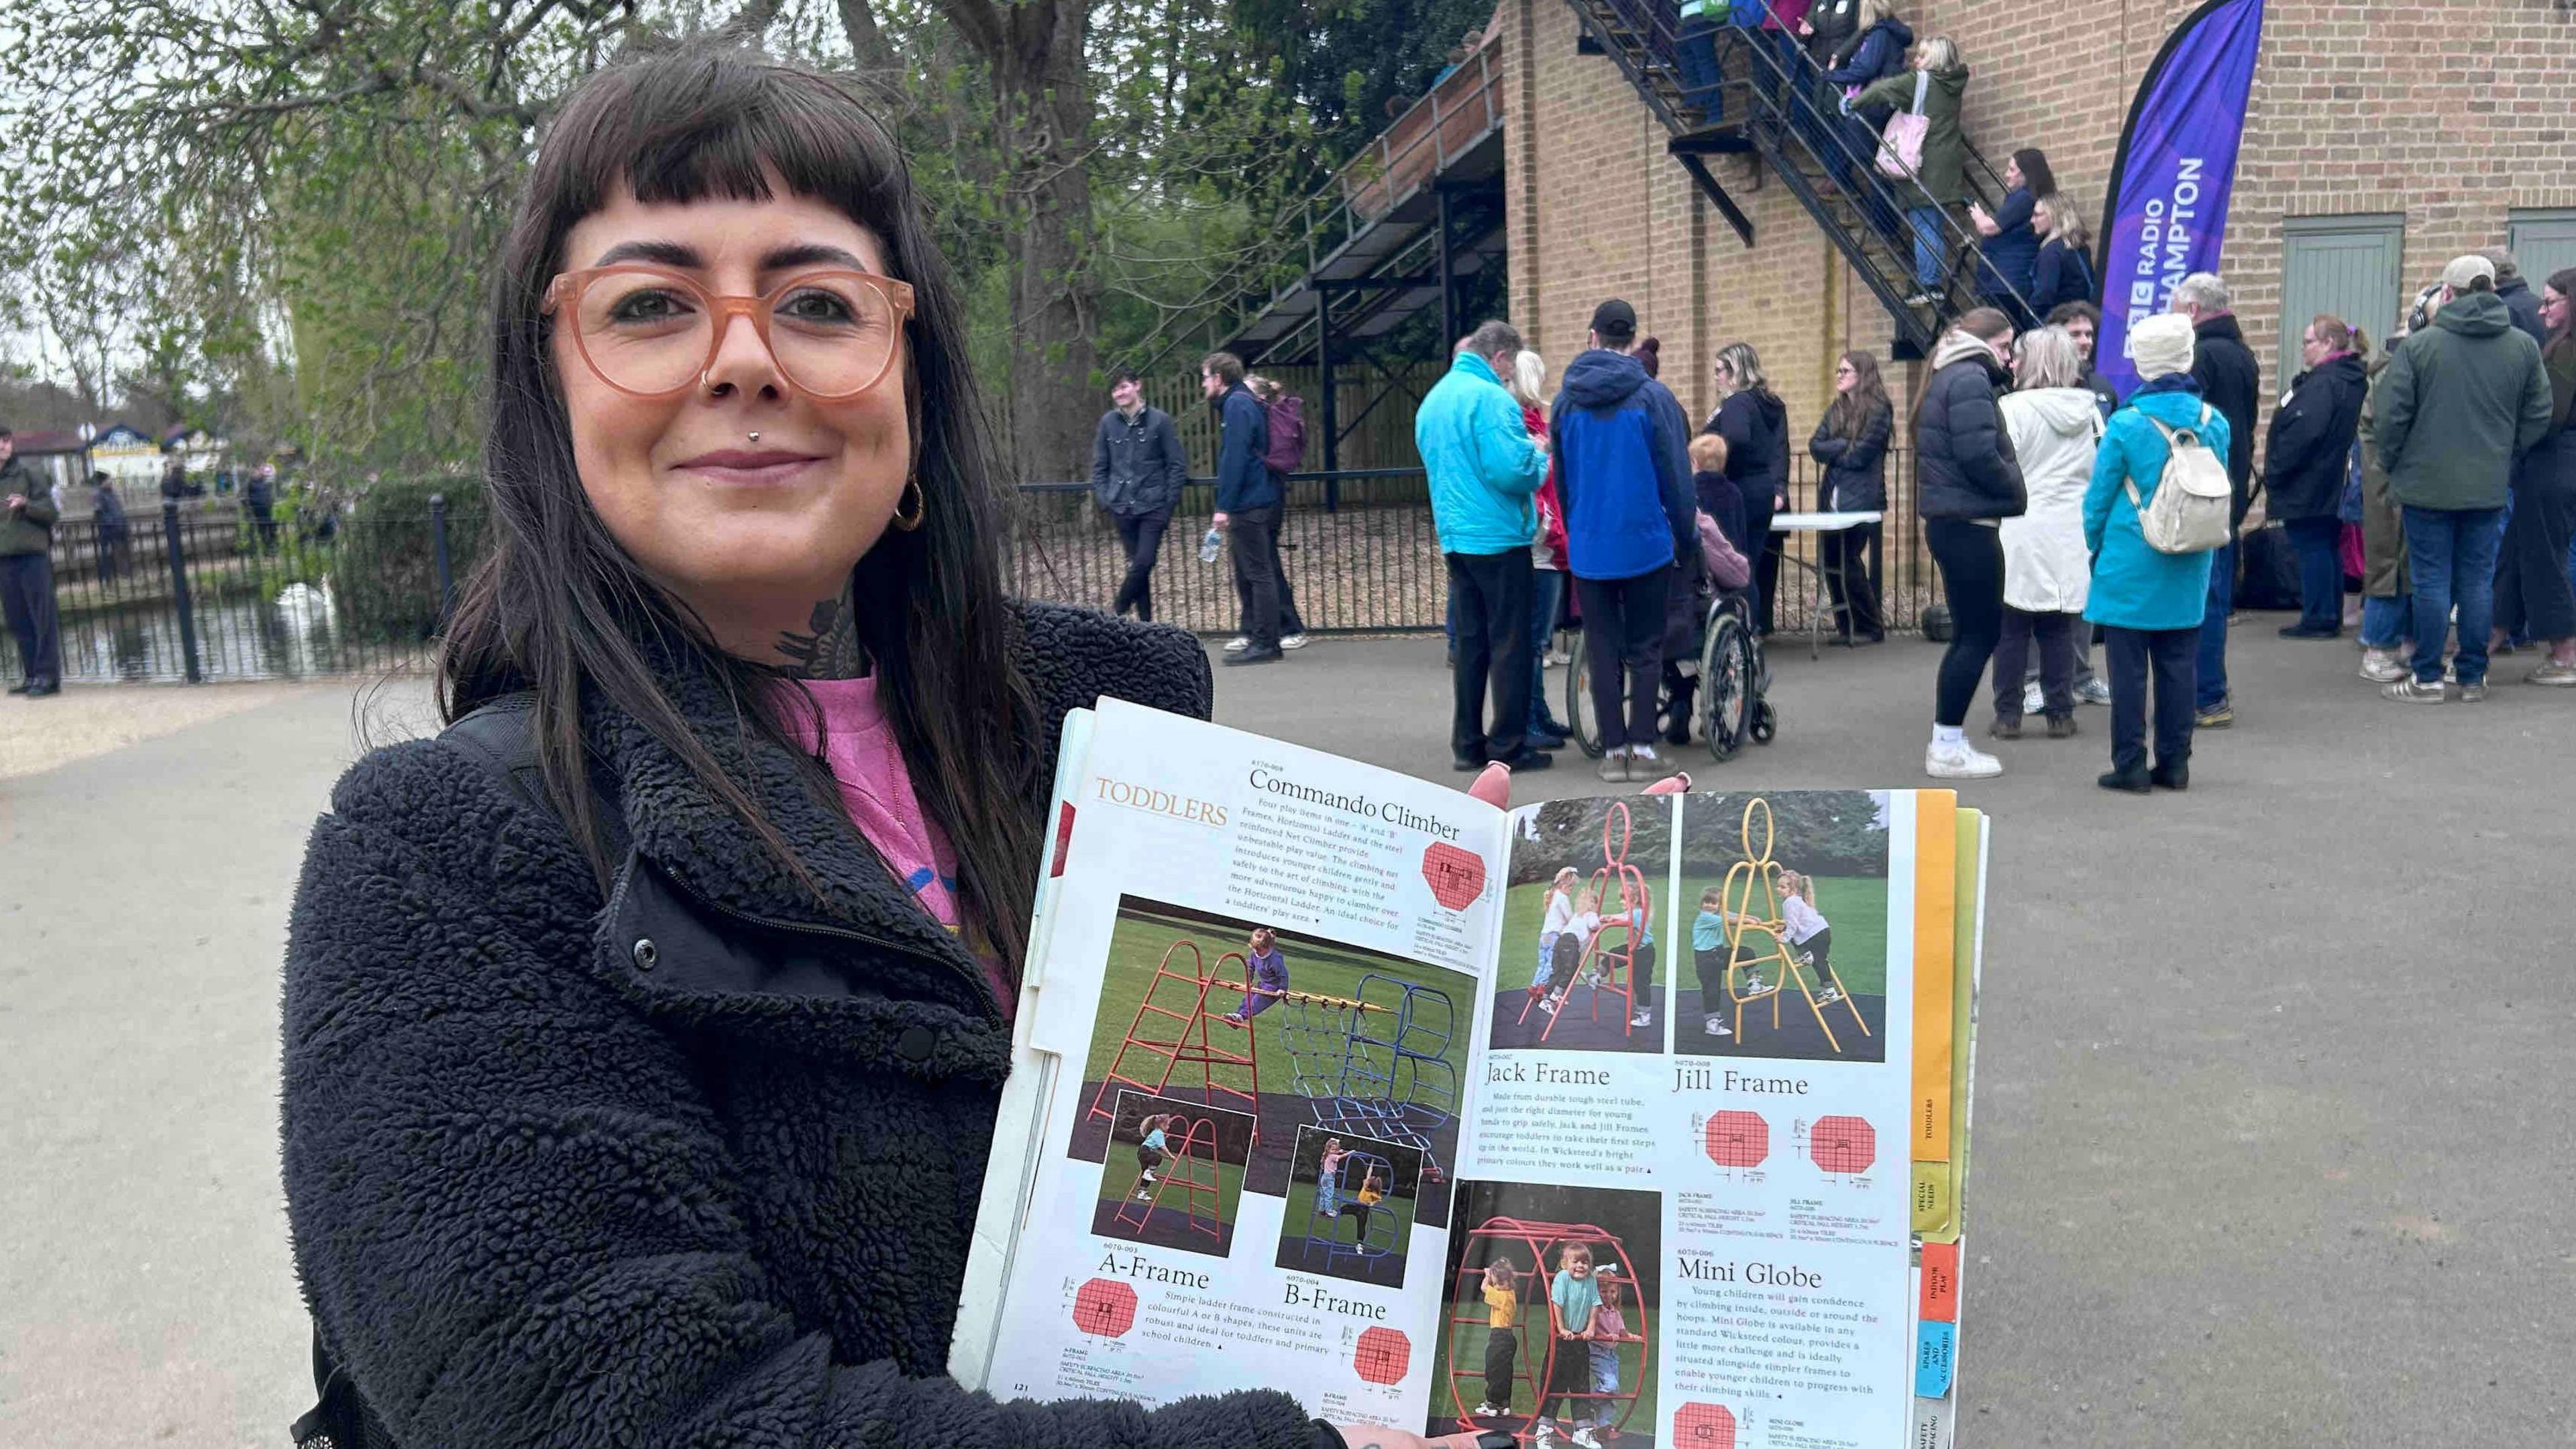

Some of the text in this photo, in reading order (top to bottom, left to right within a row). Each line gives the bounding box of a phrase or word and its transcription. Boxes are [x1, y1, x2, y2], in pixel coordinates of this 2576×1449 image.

[2137, 199, 2165, 276] RADIO
[1097, 777, 1228, 826] TODDLERS
[1250, 769, 1460, 841] Commando Climber
[1485, 1062, 1610, 1085] Jack Frame
[1672, 1069, 1808, 1095] Jill Frame
[1925, 1099, 1933, 1140] TODDLERS
[1098, 1252, 1210, 1289] A-Frame
[1678, 1257, 1821, 1289] Mini Globe
[1165, 1292, 1195, 1303] Simple
[1199, 1297, 1226, 1309] ladder
[1283, 1283, 1387, 1320] B-Frame
[1693, 1287, 1721, 1298] Young
[1724, 1289, 1764, 1299] children
[1788, 1295, 1808, 1303] gain
[1812, 1297, 1864, 1307] confidence
[1148, 1304, 1189, 1316] colourful
[1677, 1299, 1688, 1309] by
[1690, 1301, 1731, 1312] climbing
[1862, 1314, 1878, 1323] the
[1142, 1330, 1171, 1340] school
[1145, 1318, 1173, 1327] robust
[1197, 1325, 1218, 1335] ideal
[1295, 1343, 1328, 1354] primary
[1676, 1328, 1717, 1337] standard
[1712, 1316, 1733, 1324] Mini
[1736, 1318, 1765, 1328] Globe
[1780, 1323, 1821, 1332] available
[1825, 1326, 1834, 1334] in
[1837, 1328, 1854, 1336] any
[1676, 1340, 1698, 1350] little
[1702, 1344, 1725, 1352] more
[1729, 1346, 1773, 1357] challenge
[1809, 1352, 1841, 1363] ideally
[1014, 1383, 1028, 1391] 121
[1675, 1370, 1705, 1378] enable
[1750, 1376, 1790, 1387] children
[1794, 1379, 1804, 1388] to
[1807, 1383, 1847, 1392] progress
[1851, 1385, 1873, 1394] with
[1675, 1383, 1697, 1391] their
